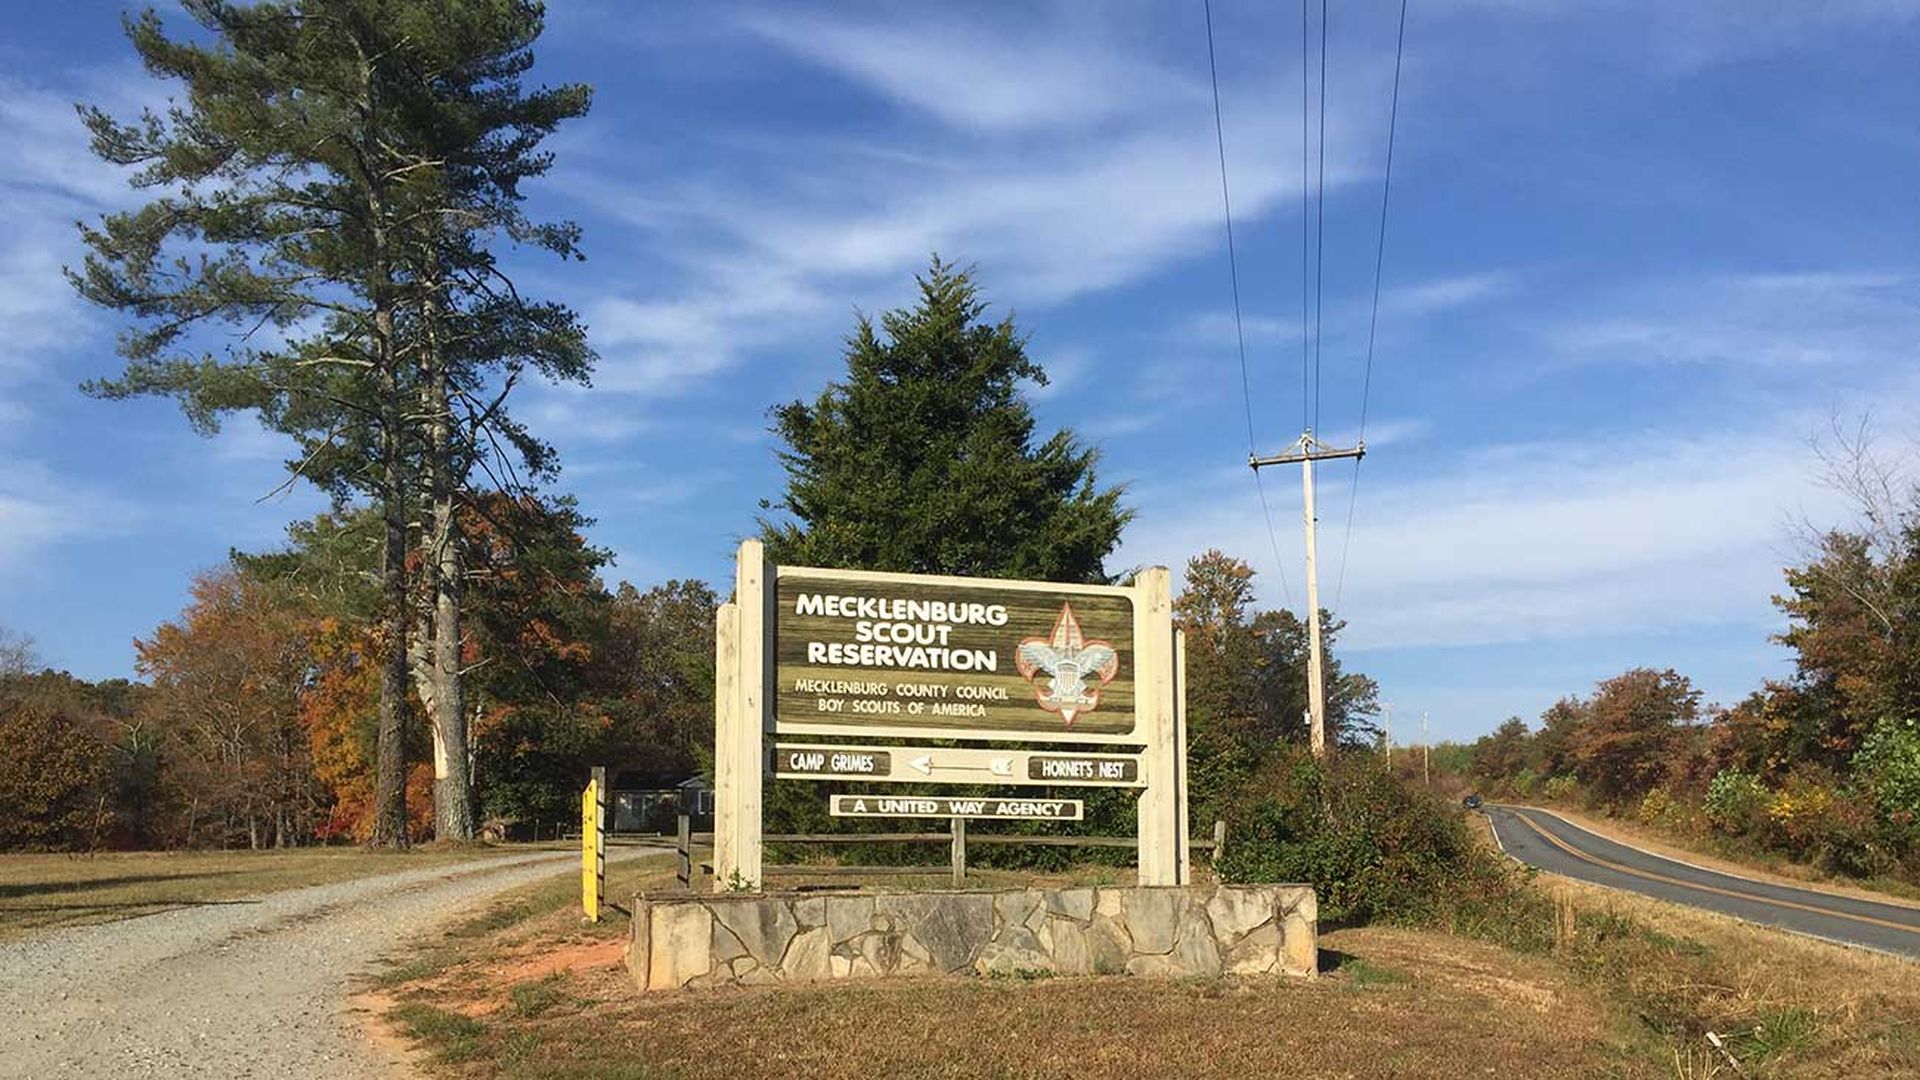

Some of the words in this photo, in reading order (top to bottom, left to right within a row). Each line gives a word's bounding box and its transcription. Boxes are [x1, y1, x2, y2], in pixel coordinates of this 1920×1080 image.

[796, 594, 1008, 626] MECKLENBURG
[855, 621, 952, 646] SCOUT
[807, 642, 997, 672] RESERVATION
[795, 679, 888, 697] MECKLENBURG
[896, 684, 948, 699] COUNTY
[956, 687, 1009, 701] COUNCIL
[818, 699, 844, 713] BOY
[852, 700, 900, 715] SCOUTS
[908, 702, 924, 716] OF
[932, 702, 986, 718] AMERICA
[790, 752, 824, 772] CAMP
[831, 753, 874, 773] GRIMES
[1100, 762, 1125, 779] NEST
[853, 800, 867, 813] A
[878, 800, 938, 814] UNITED
[950, 801, 984, 815] WAY
[996, 802, 1064, 817] AGENCY
